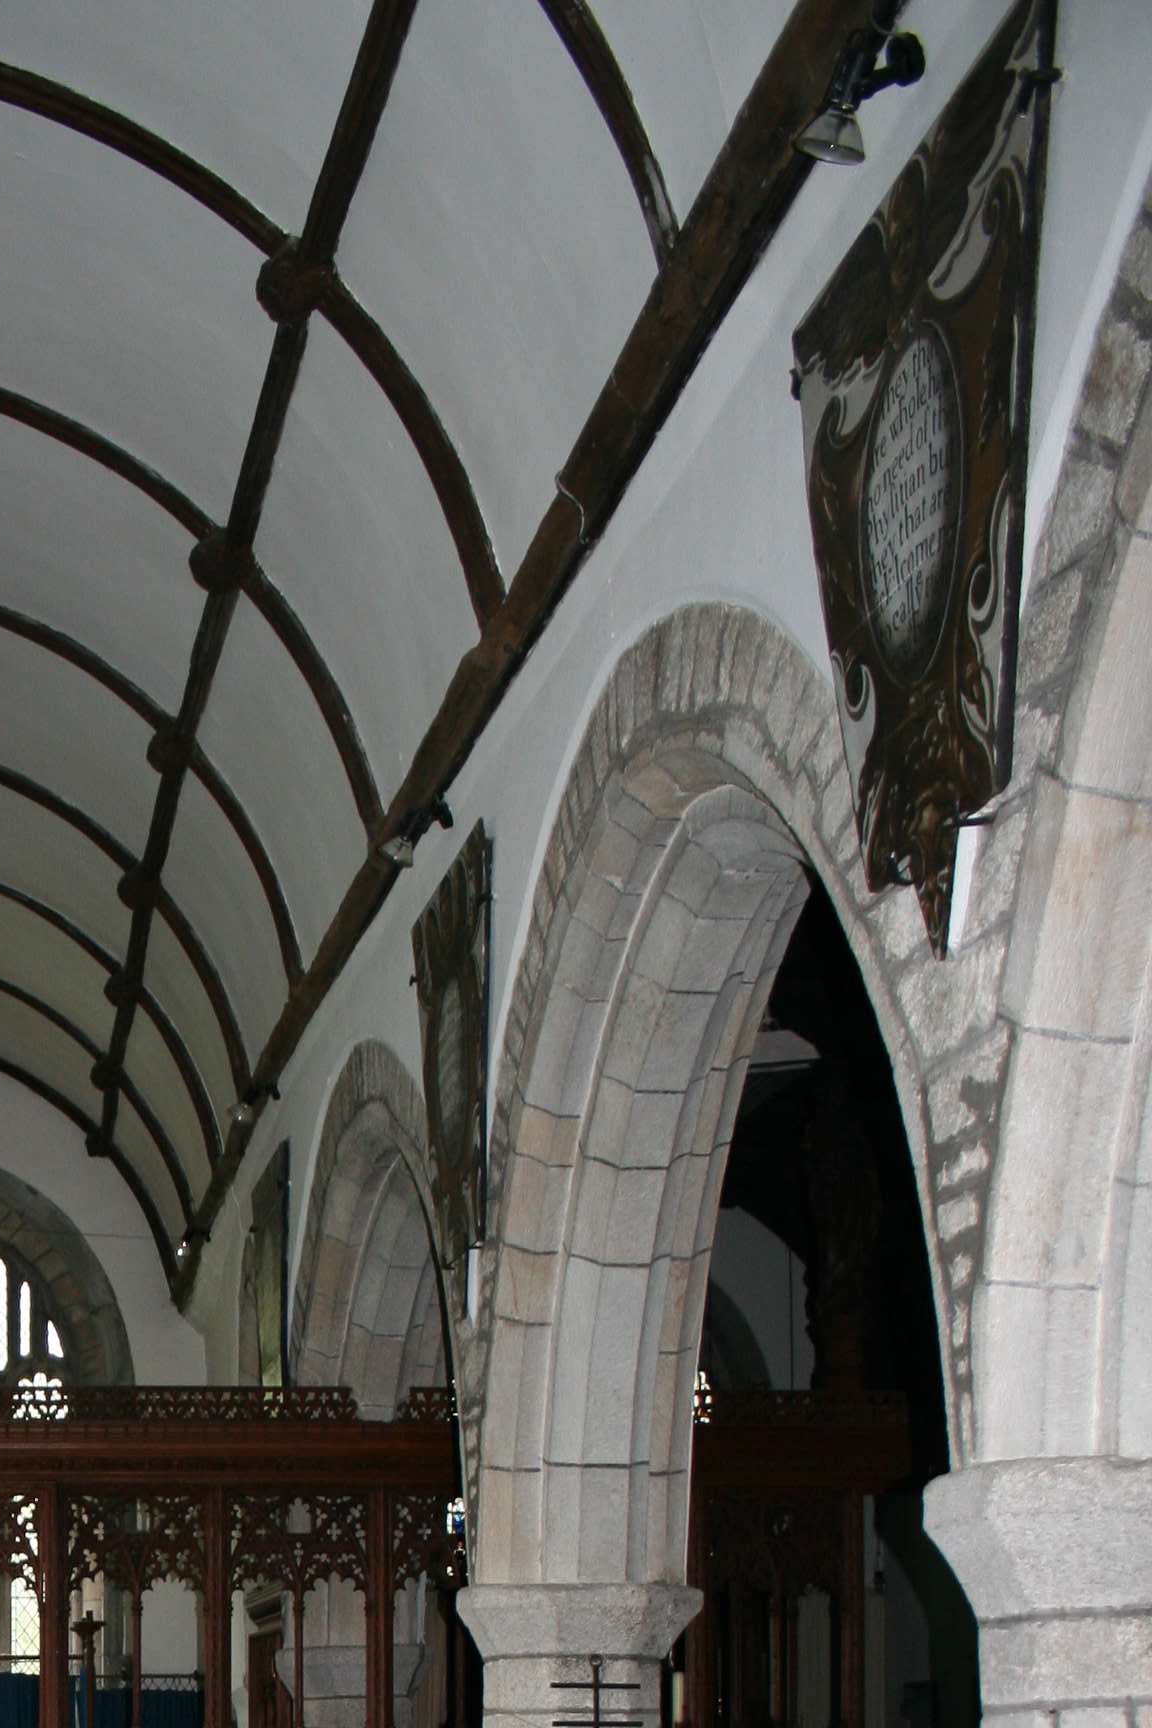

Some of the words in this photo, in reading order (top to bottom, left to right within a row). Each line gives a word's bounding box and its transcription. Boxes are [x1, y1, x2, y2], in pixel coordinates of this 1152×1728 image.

[889, 376, 927, 442] whole
[883, 420, 914, 493] need
[916, 403, 930, 451] of
[898, 496, 927, 546] that
